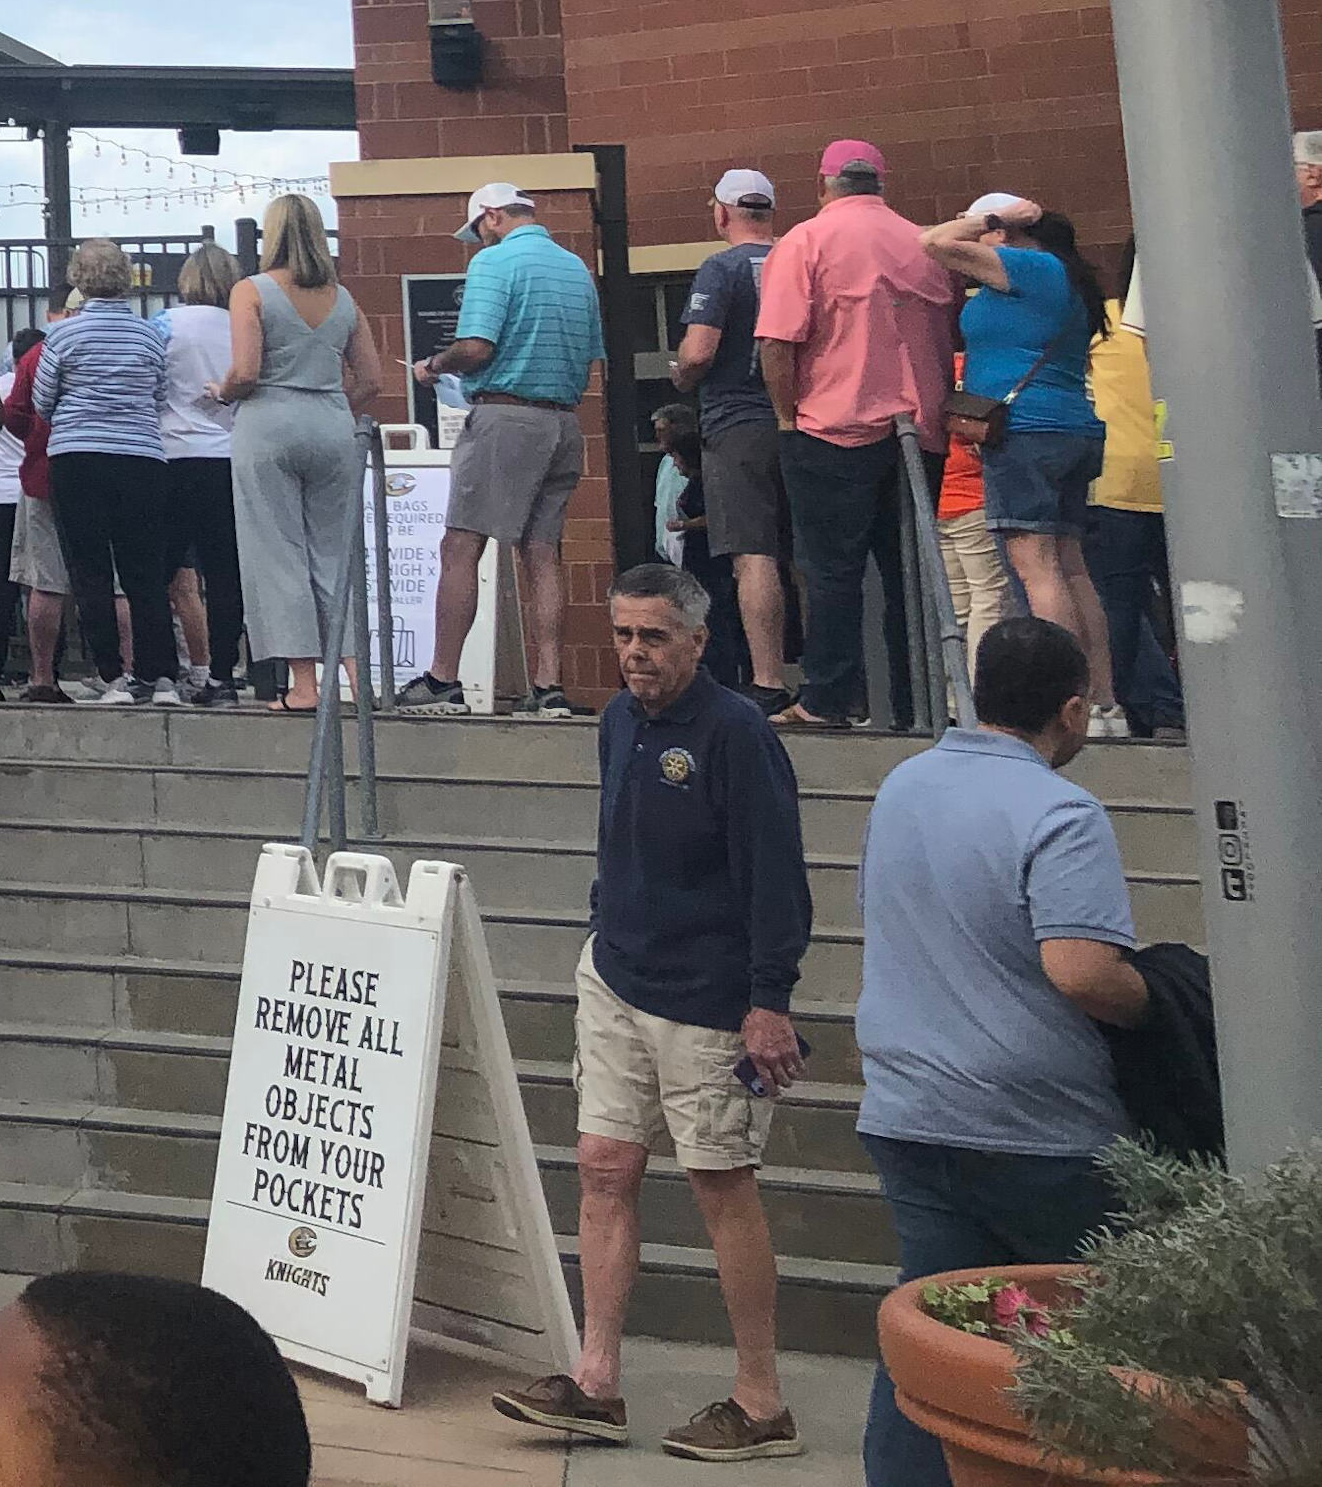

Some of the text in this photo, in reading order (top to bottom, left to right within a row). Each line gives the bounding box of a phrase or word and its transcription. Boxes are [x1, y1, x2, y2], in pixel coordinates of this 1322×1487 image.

[386, 513, 444, 524] EQUIRED
[392, 500, 429, 512] BAGS
[398, 525, 414, 536] BE
[289, 959, 380, 1008] PLEASE
[254, 997, 404, 1057] REMOVE ALL
[283, 1044, 363, 1094] METAL
[264, 1086, 375, 1140] OBJECTS
[242, 1121, 385, 1189] FROM YOUR
[252, 1168, 364, 1229] POCKETS
[263, 1257, 331, 1298] KNIGHTS
